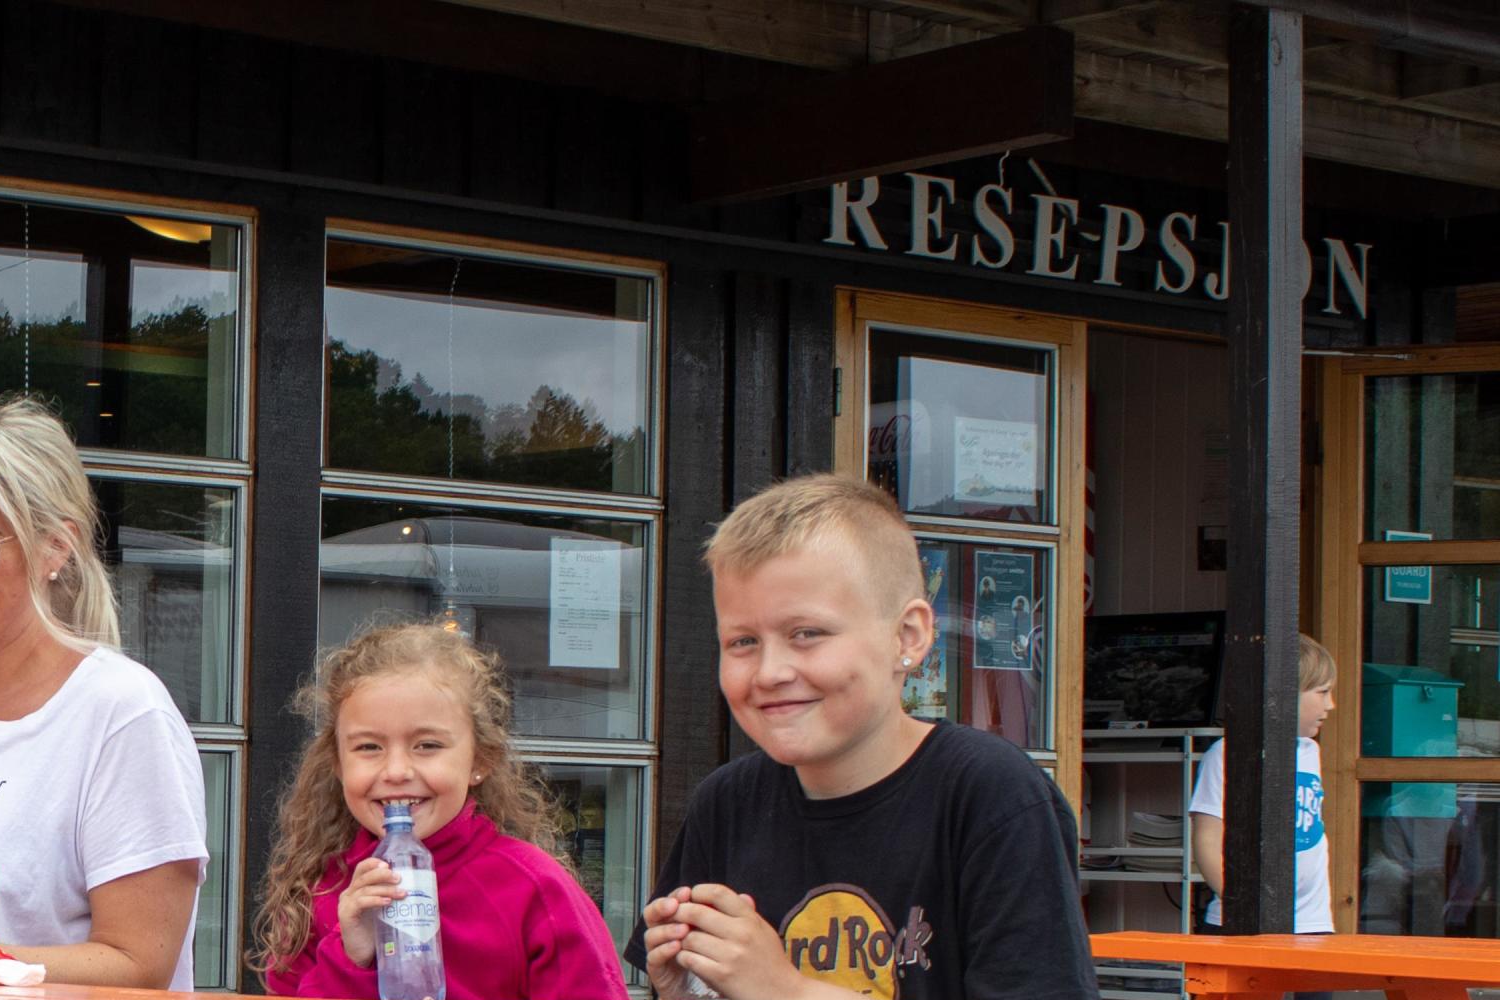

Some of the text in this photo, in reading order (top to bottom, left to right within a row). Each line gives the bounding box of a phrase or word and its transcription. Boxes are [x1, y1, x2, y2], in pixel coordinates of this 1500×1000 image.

[822, 175, 1374, 320] RESEPSJN
[790, 906, 933, 981] rd Rock
